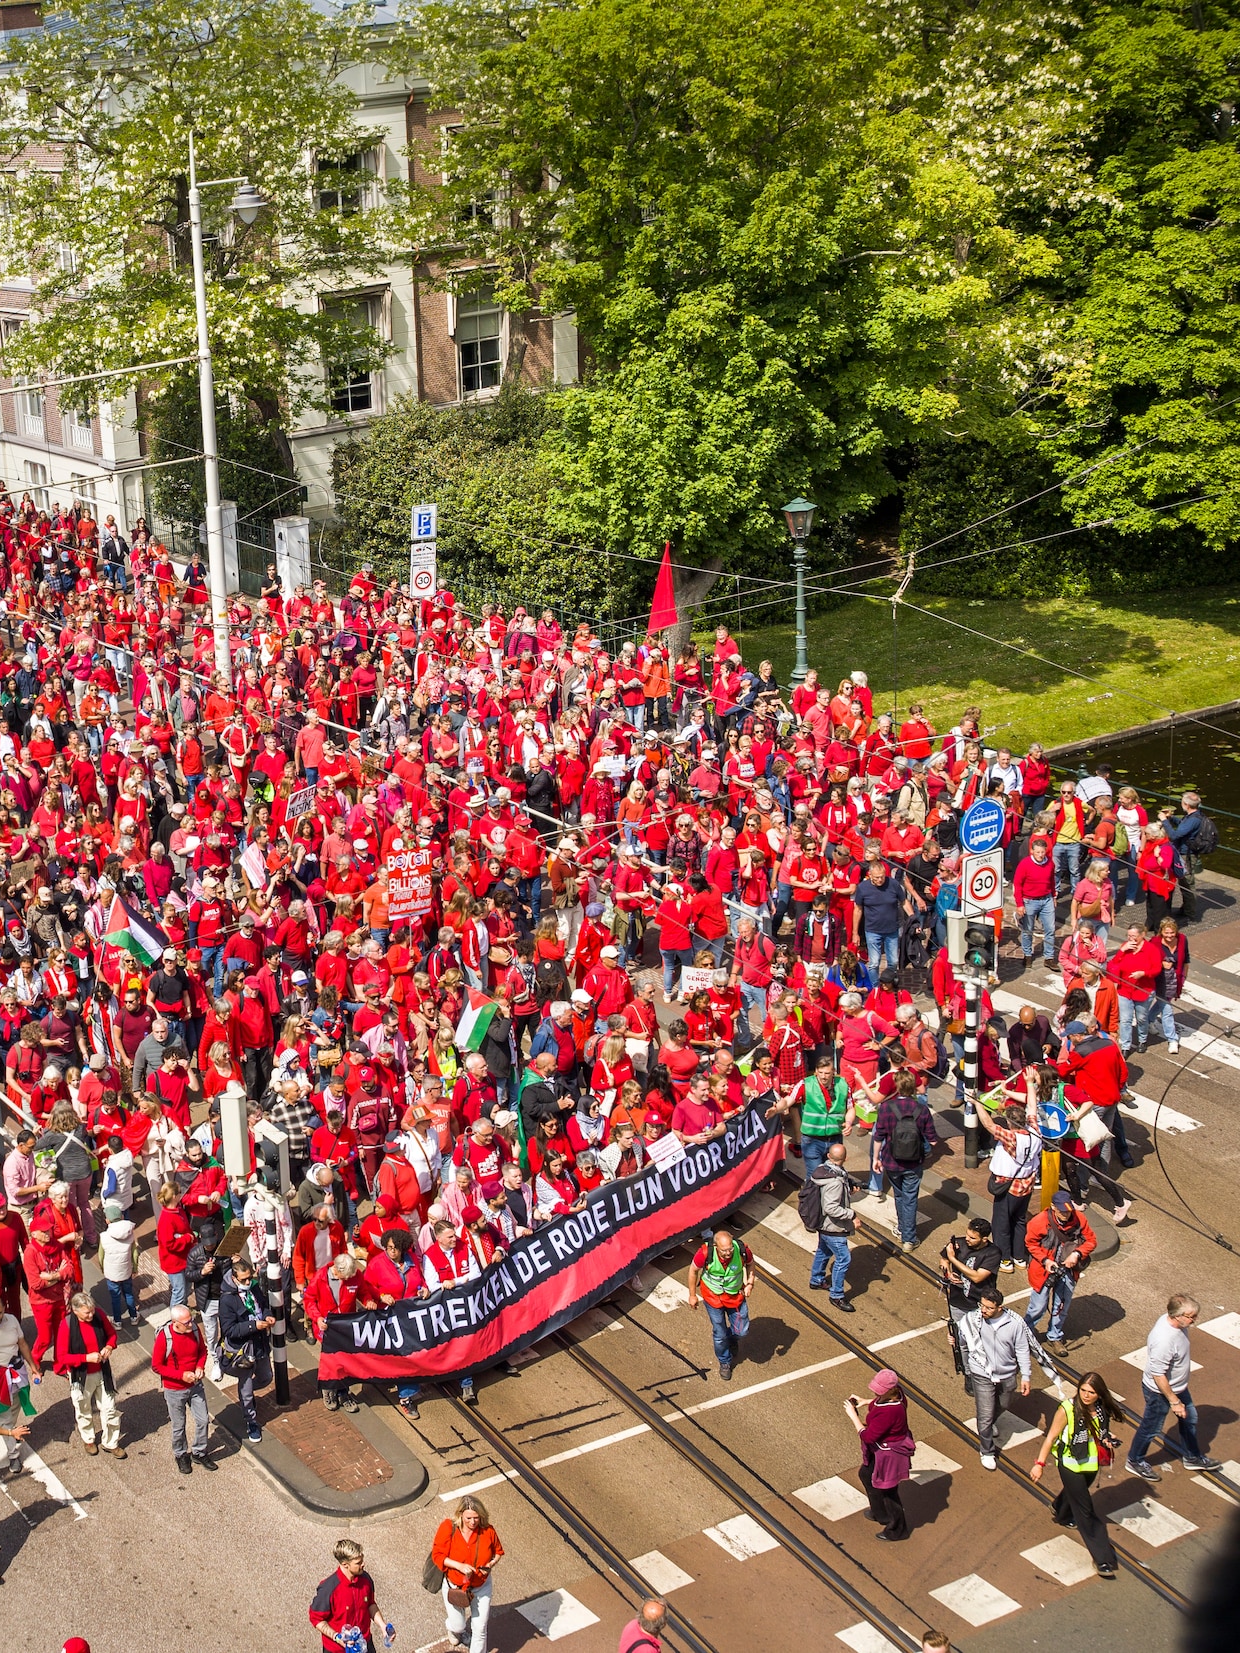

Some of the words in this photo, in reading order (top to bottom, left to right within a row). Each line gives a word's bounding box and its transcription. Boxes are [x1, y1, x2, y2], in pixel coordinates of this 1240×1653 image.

[417, 576, 430, 585] 30
[387, 849, 432, 872] BOYCOTT
[976, 856, 992, 866] ZONE
[974, 875, 994, 892] 30
[352, 1316, 404, 1350] WIJ
[408, 1263, 518, 1342] TREKKEN
[512, 1240, 552, 1284] DE
[548, 1200, 610, 1261] RODE
[612, 1172, 665, 1222] LIJN
[666, 1142, 725, 1193] VOOR
